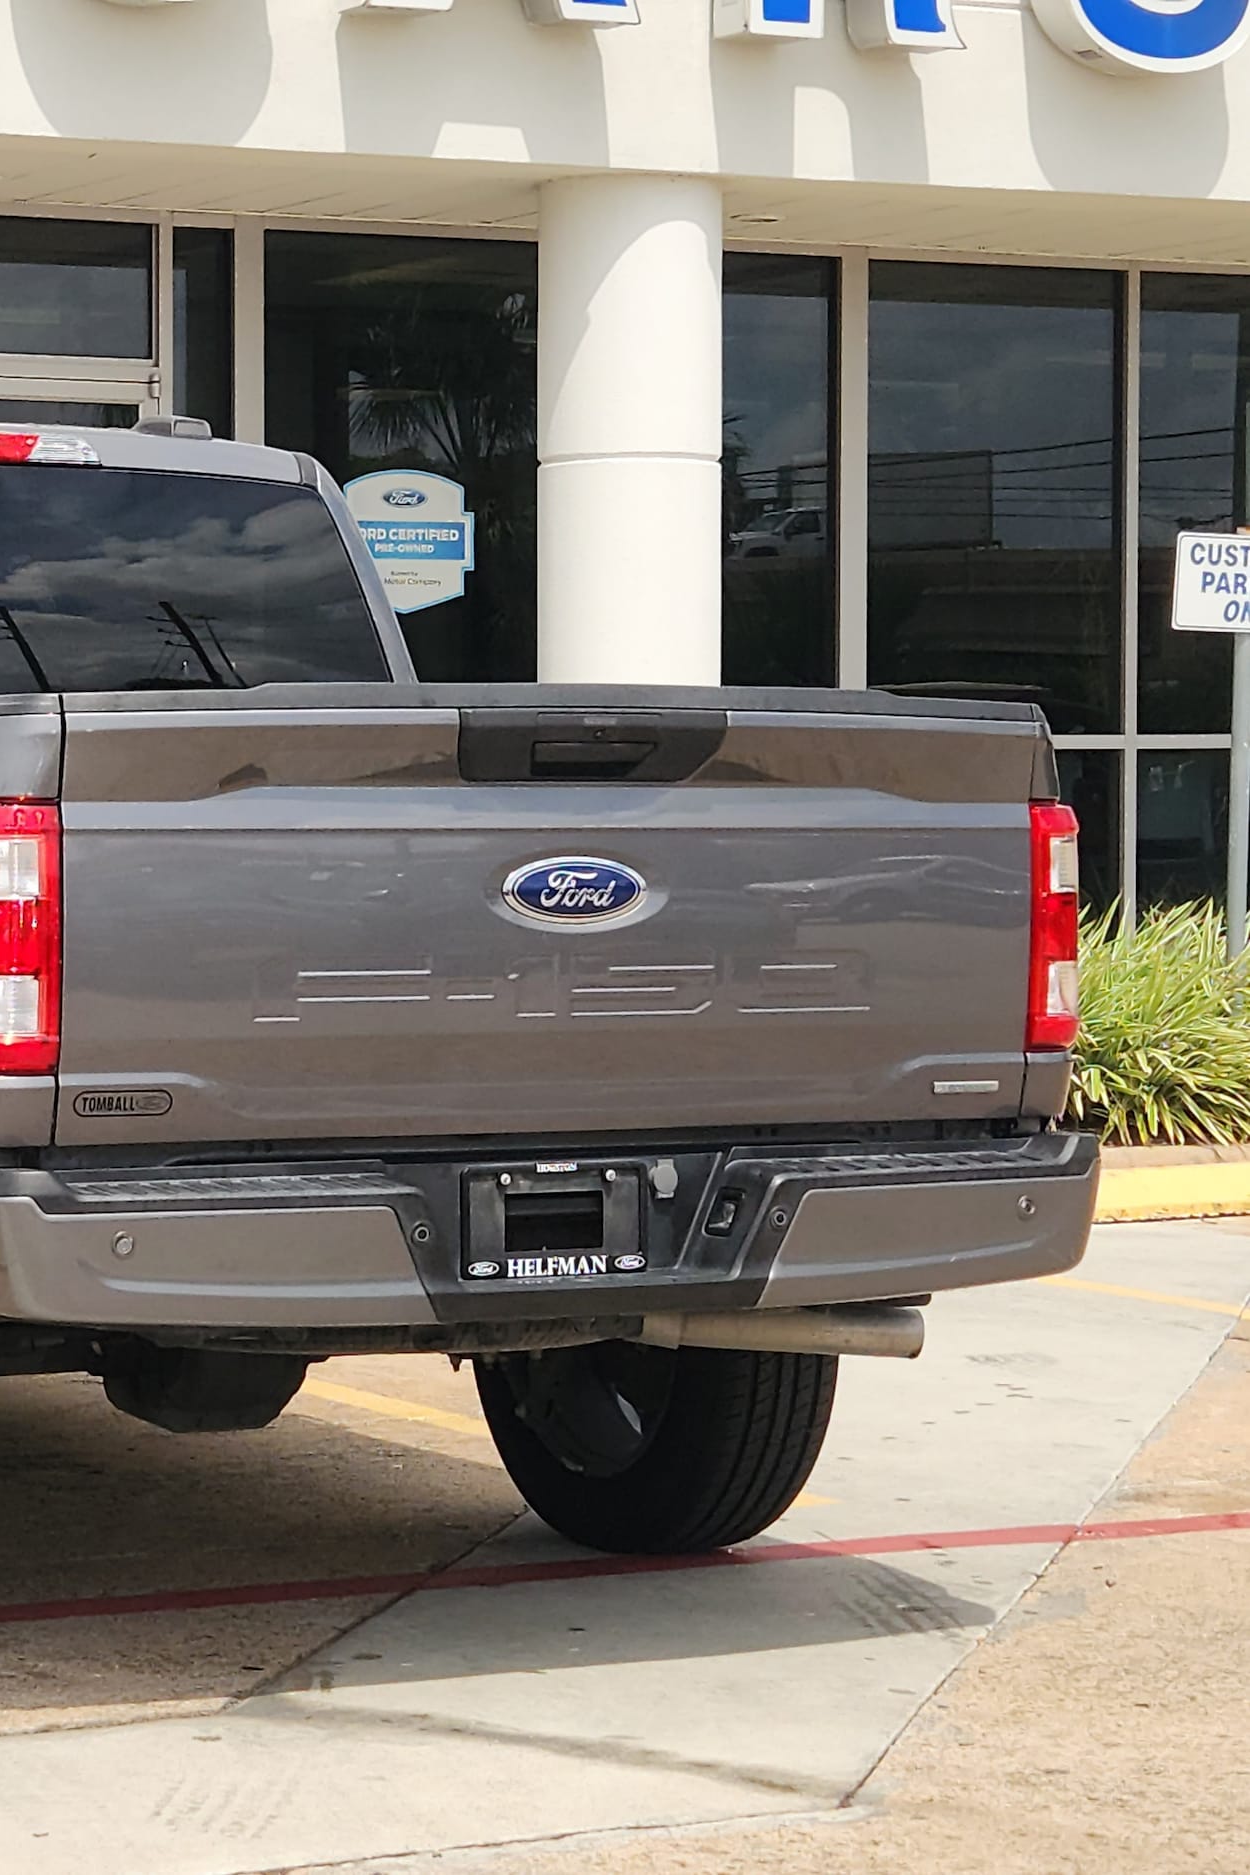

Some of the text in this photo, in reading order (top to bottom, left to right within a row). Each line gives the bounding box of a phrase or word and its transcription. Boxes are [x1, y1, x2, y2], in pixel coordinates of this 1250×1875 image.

[389, 489, 420, 505] Ford
[360, 528, 460, 541] ORD CERTIFIED
[374, 543, 435, 554] PRE-OWNED
[540, 869, 617, 908] Ford
[81, 1096, 135, 1112] TOMBALL
[507, 1254, 608, 1278] HELFMAN
